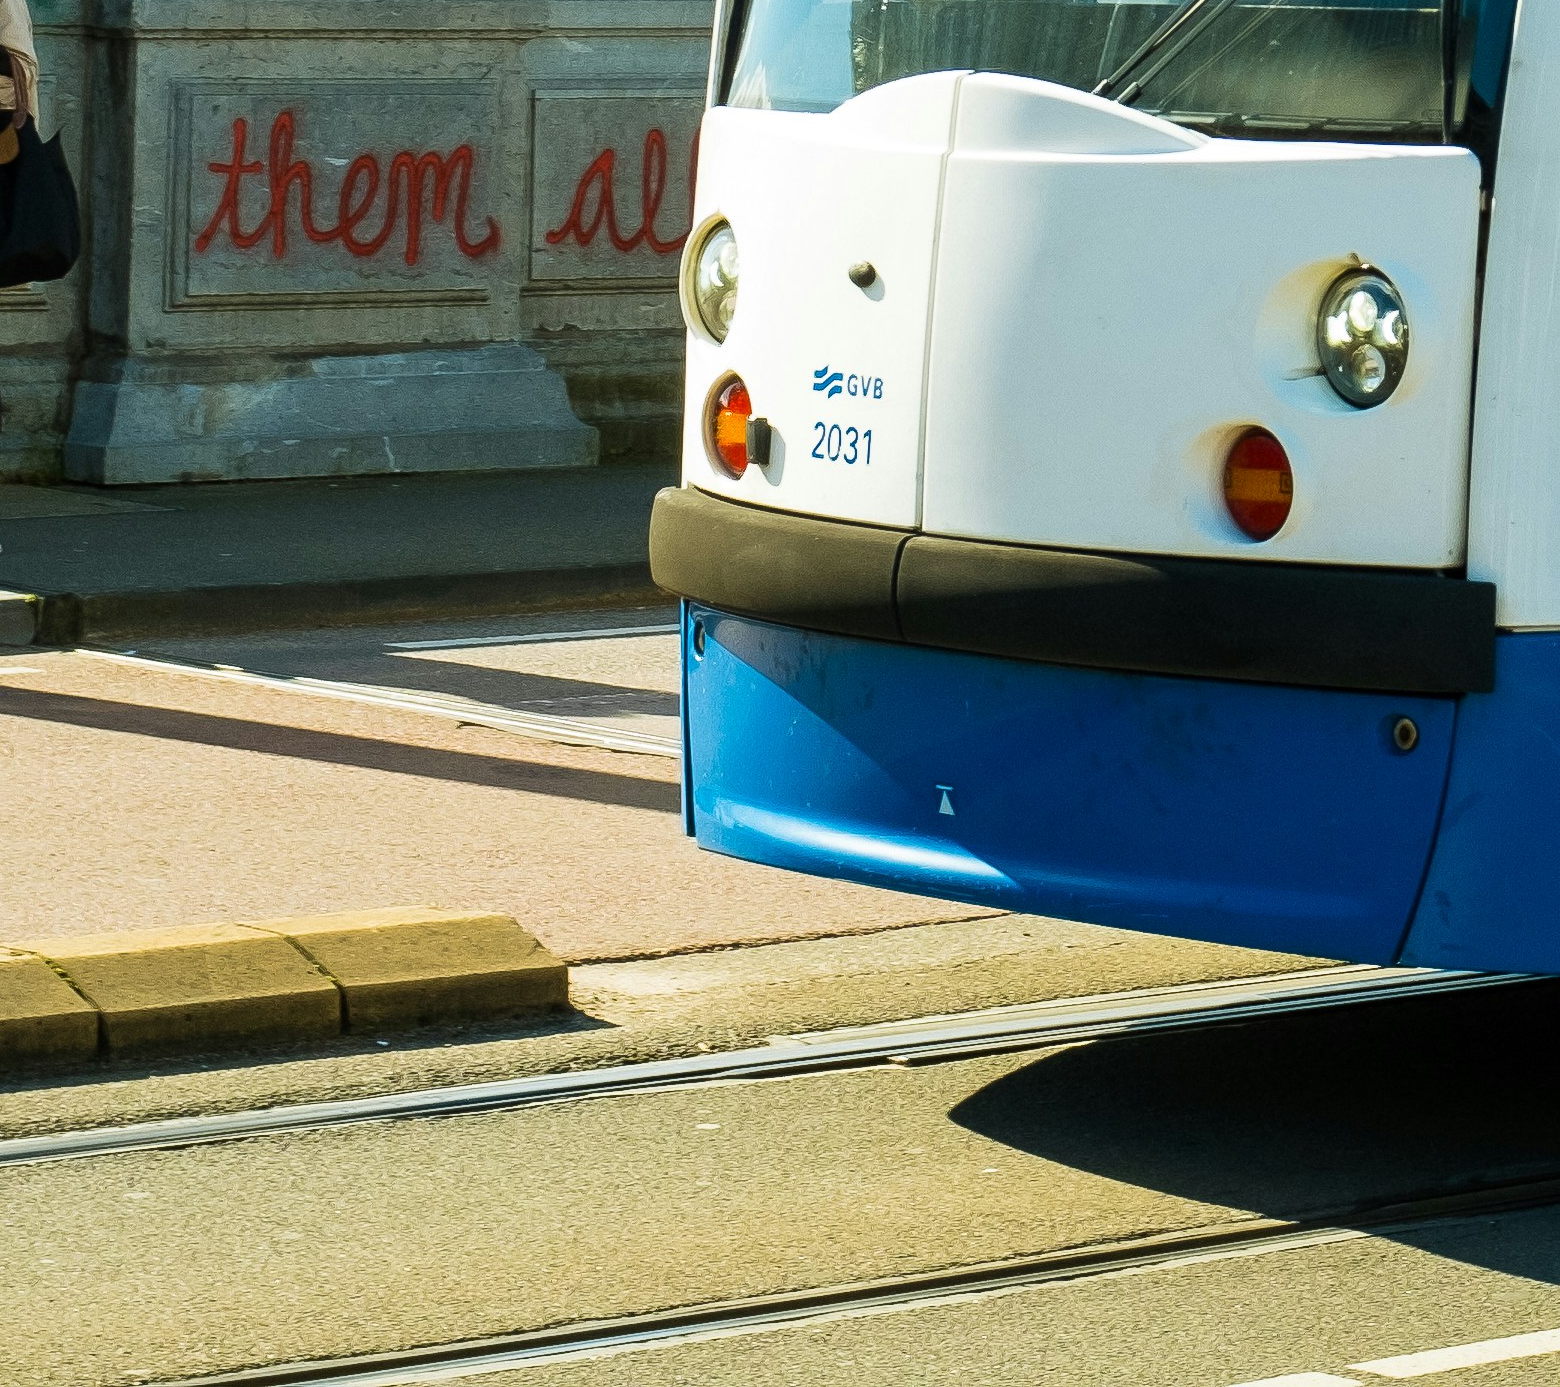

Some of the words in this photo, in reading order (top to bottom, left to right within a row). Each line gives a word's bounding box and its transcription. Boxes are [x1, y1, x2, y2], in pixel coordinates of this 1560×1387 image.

[192, 109, 502, 267] them
[545, 127, 702, 254] al
[847, 373, 884, 400] GVB
[810, 420, 873, 466] 2031
